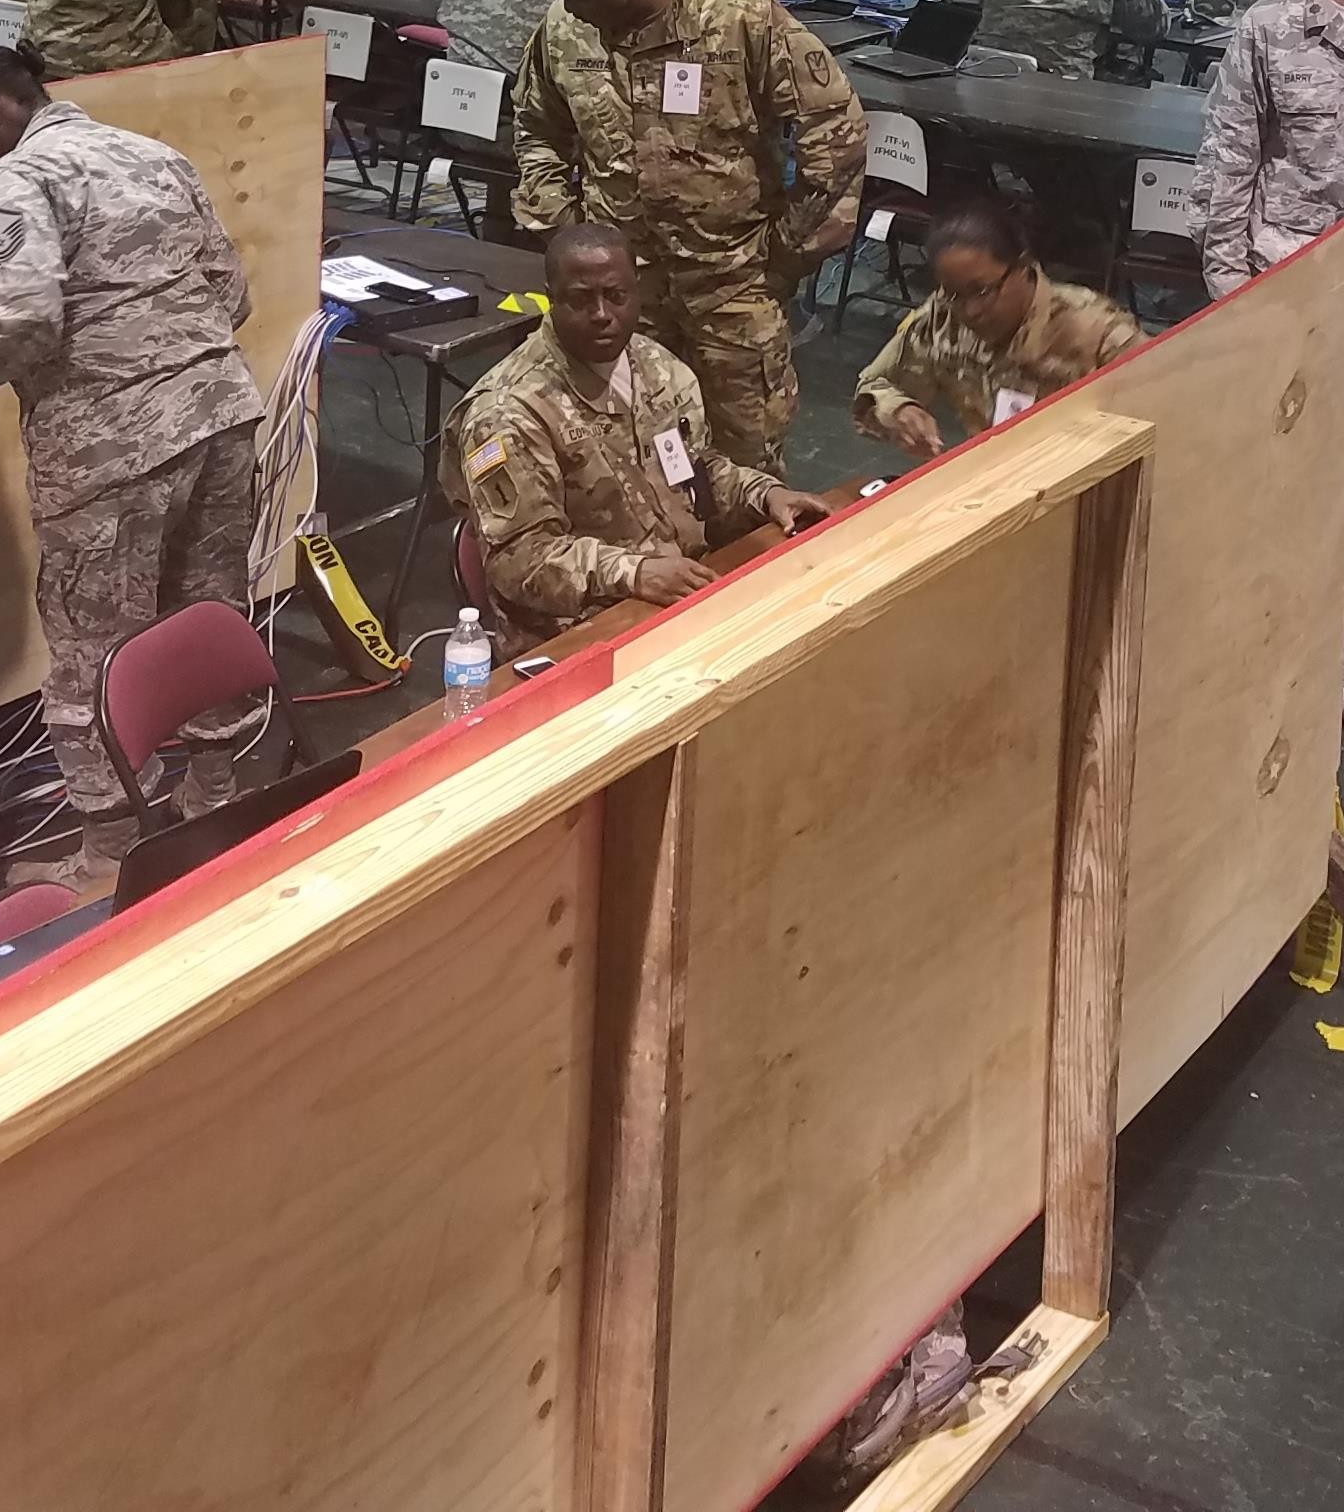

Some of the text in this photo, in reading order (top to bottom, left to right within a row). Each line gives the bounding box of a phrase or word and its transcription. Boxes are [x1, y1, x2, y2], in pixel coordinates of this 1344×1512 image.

[1284, 73, 1313, 85] BARRY
[451, 88, 477, 99] JTF-VI
[885, 135, 910, 149] JTF-VI
[874, 146, 916, 165] JFHQ LNO
